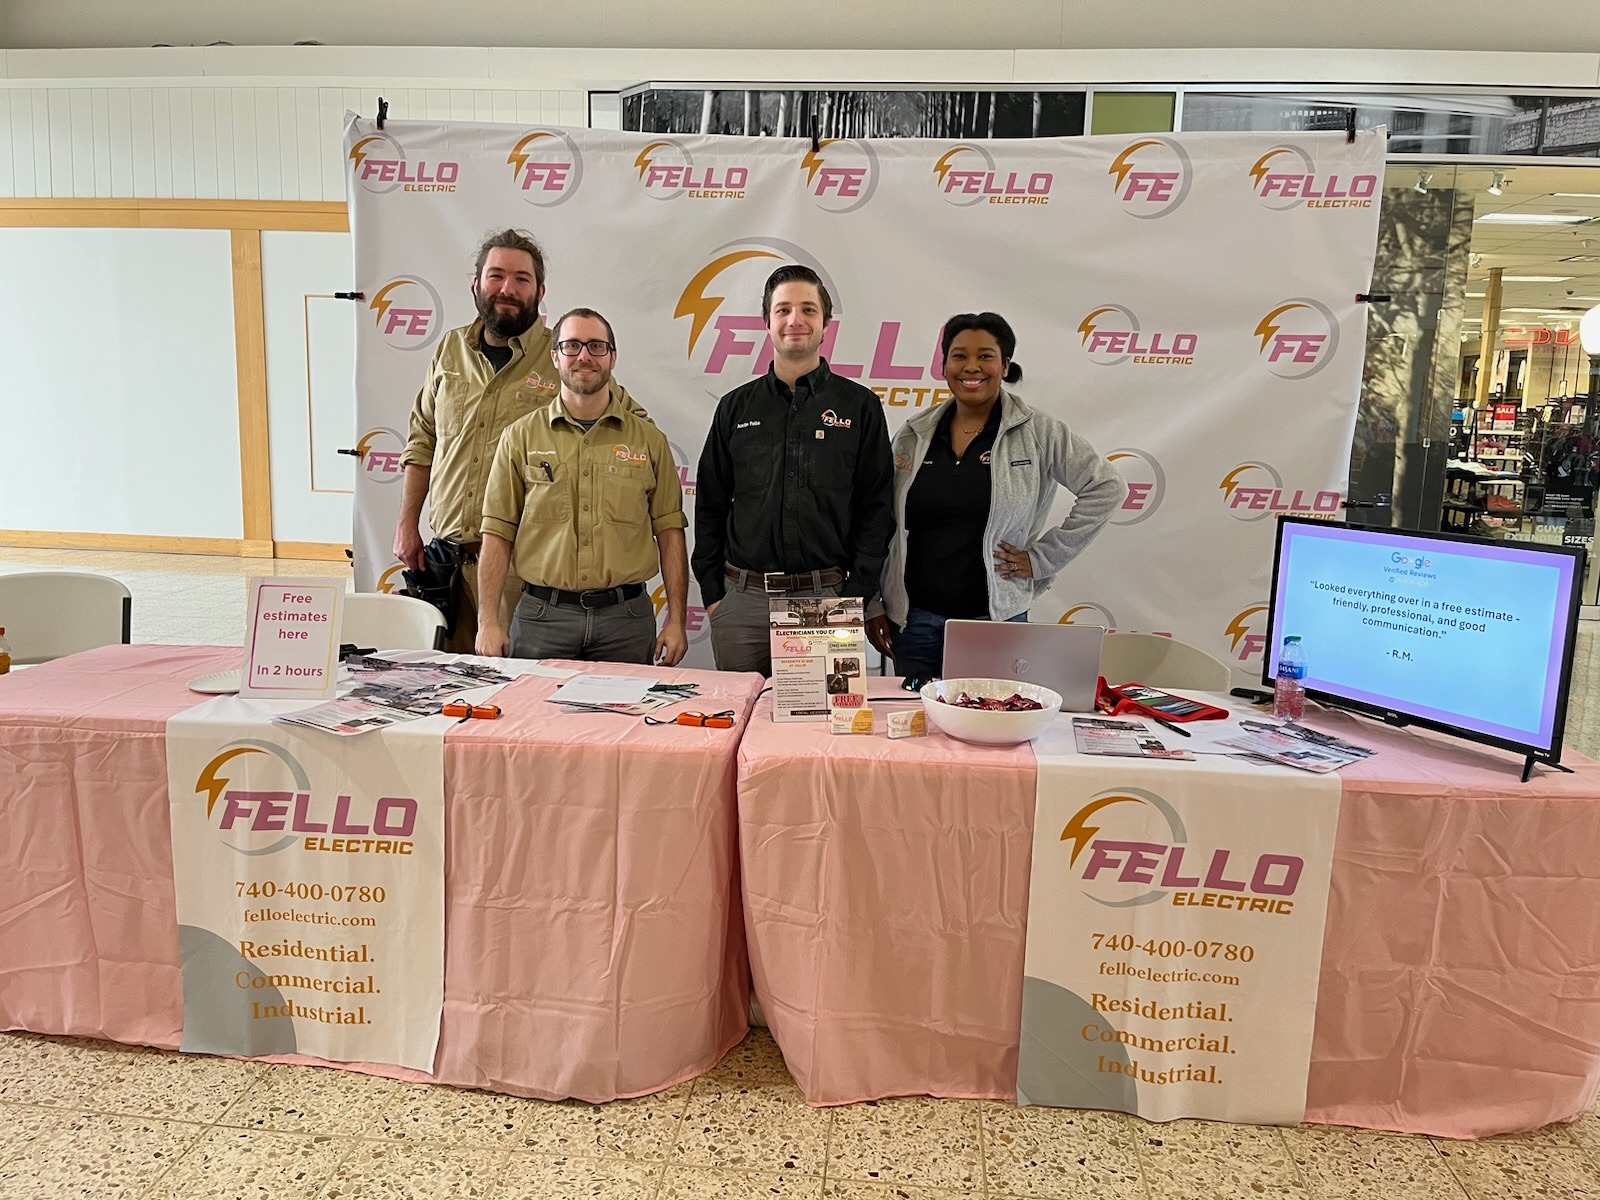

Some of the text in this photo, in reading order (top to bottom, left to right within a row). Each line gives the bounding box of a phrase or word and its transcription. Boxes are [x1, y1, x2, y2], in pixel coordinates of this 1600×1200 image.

[361, 160, 458, 182] FELLO
[522, 162, 571, 190] FE
[646, 166, 748, 188] FELLO
[815, 168, 866, 197] FE
[945, 171, 1053, 194] FELLO
[404, 184, 456, 192] ELECTRIC
[688, 190, 745, 198] ELECTRIC
[1123, 172, 1179, 202] FE
[1261, 174, 1377, 198] FELLO
[989, 196, 1049, 205] ELECTRIC
[1307, 199, 1372, 208] ELECTRIC
[384, 308, 432, 336] FE
[704, 315, 948, 381] FLL
[1088, 331, 1198, 355] FELLO
[1269, 334, 1326, 363] FE
[1133, 355, 1194, 365] ELECTRIC
[526, 377, 556, 390] FELLO
[824, 416, 851, 426] FELLO
[615, 450, 647, 461] FELLO
[1230, 487, 1341, 512] FELLO
[1536, 524, 1565, 534] GUYS
[1564, 536, 1595, 544] SIZES
[1391, 551, 1431, 569] Google
[1384, 566, 1437, 580] Verified Reviews
[282, 593, 313, 604] Free
[1347, 587, 1396, 604] everything
[1398, 596, 1419, 605] over
[1421, 598, 1430, 608] in
[1433, 601, 1439, 609] a
[1441, 601, 1462, 613] free
[1464, 607, 1513, 622] estimate
[263, 610, 328, 622] estimates
[1333, 597, 1486, 632] friendly, professional, and good
[279, 628, 308, 640] here
[1392, 649, 1414, 662] R.M.
[257, 665, 323, 677] In 2 hours
[1279, 664, 1299, 673] DASANI
[834, 695, 859, 703] FREE
[219, 791, 418, 837] FELLO
[304, 837, 414, 855] ELECTRIC
[1082, 840, 1304, 896] FELLO
[235, 880, 386, 903] 740-400-0780
[1172, 892, 1293, 915] ELECTRIC
[244, 908, 376, 927] felloelectric.com
[239, 939, 375, 963] Residential.
[1091, 932, 1254, 963] 740-400-0780
[235, 971, 381, 994] Commercial.
[1099, 962, 1240, 986] felloelectric.com
[252, 999, 372, 1025] Industrial.
[1091, 992, 1233, 1022] Residential.
[1081, 1024, 1236, 1055] Commercial.
[1096, 1055, 1223, 1085] Industrial.
